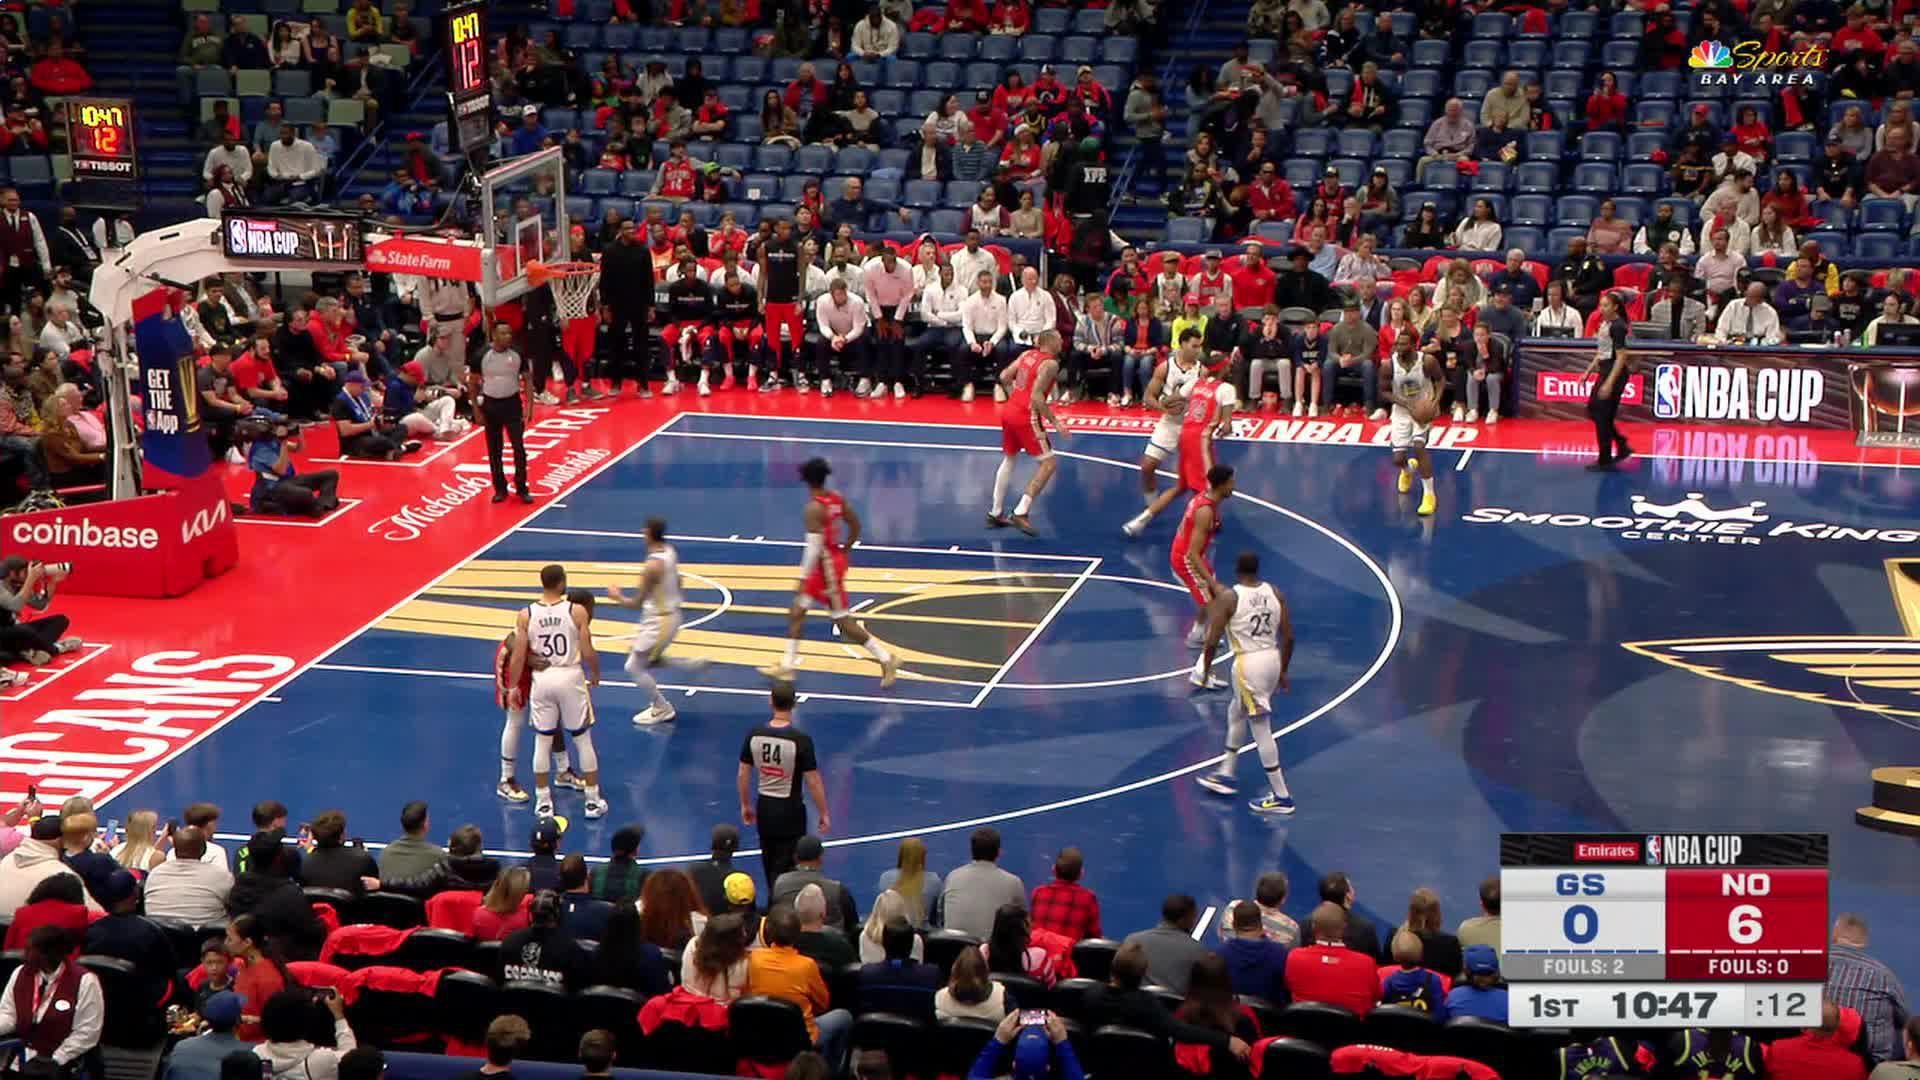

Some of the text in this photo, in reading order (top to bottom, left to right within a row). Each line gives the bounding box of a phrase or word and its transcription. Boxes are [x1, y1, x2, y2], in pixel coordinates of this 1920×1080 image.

[460, 40, 481, 89] 12
[93, 127, 117, 153] 12
[90, 160, 132, 172] TISSOT
[247, 230, 299, 254] NBA CUP
[147, 368, 171, 389] GET
[1543, 376, 1636, 399] Emirs
[148, 389, 173, 410] THE
[1684, 366, 1824, 422] NBA CUP
[156, 410, 178, 434] App
[1260, 418, 1364, 443] NBA
[367, 474, 491, 542] Michelob
[13, 516, 159, 549] coinbase
[1462, 508, 1756, 536] SMOOTHIE
[1621, 531, 1762, 546] CENTER
[1249, 612, 1273, 637] 23
[537, 632, 568, 658] 30
[762, 743, 783, 766] 24
